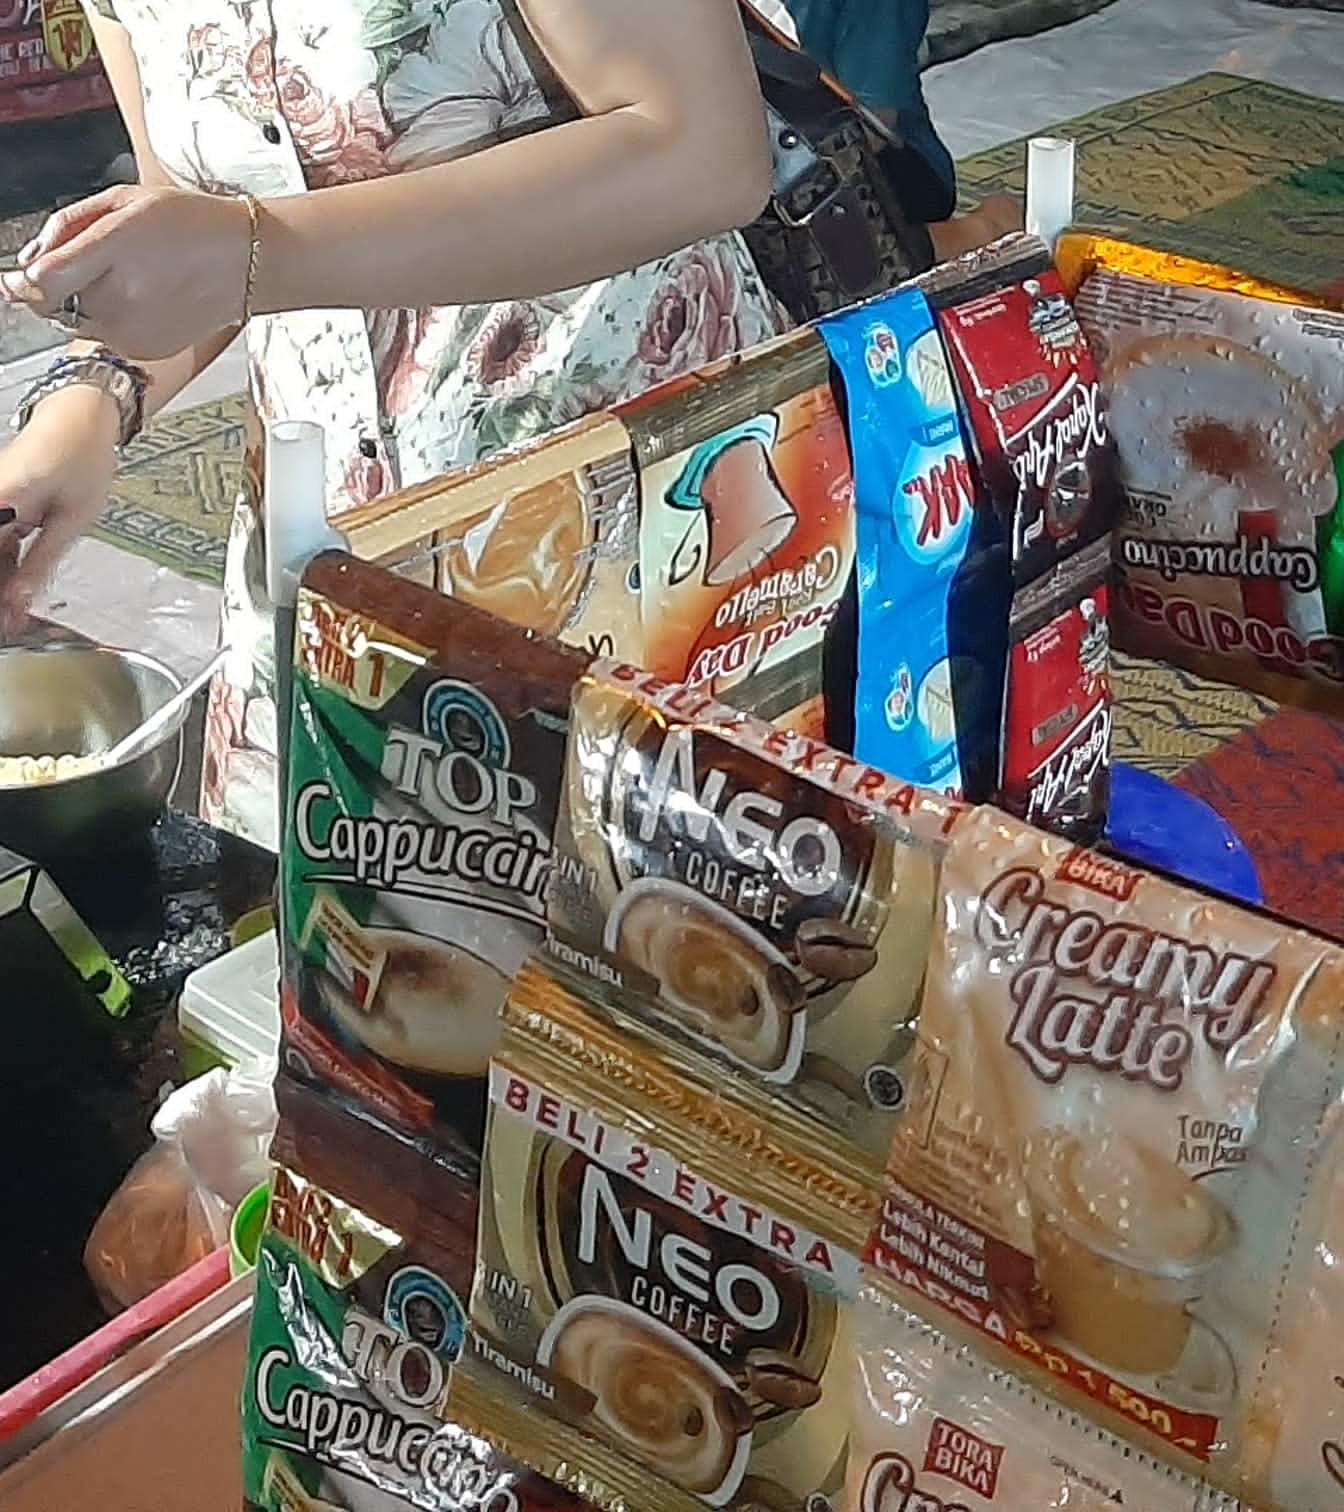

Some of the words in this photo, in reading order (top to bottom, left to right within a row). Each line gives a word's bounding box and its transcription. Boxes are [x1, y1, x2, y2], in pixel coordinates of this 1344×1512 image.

[715, 546, 839, 628] Caramello
[1124, 538, 1318, 592] Cappuccino
[385, 725, 537, 827] TOP
[762, 729, 917, 818] EXTRA
[294, 781, 555, 901] Cappuccin
[685, 850, 790, 931] COFFEE
[975, 864, 1279, 1051] Creamy
[1006, 959, 1192, 1089] Latte
[1176, 1113, 1244, 1145] Tanpa
[505, 1077, 608, 1156] BELI
[625, 1145, 652, 1181] 2
[670, 1166, 836, 1274] EXTRA
[488, 1269, 517, 1299] IN
[577, 1162, 780, 1332] NEO
[630, 1274, 737, 1357] COFFEE
[470, 1329, 557, 1401] Tiramisu
[934, 1446, 991, 1493] BIKA
[937, 1422, 993, 1473] TORA
